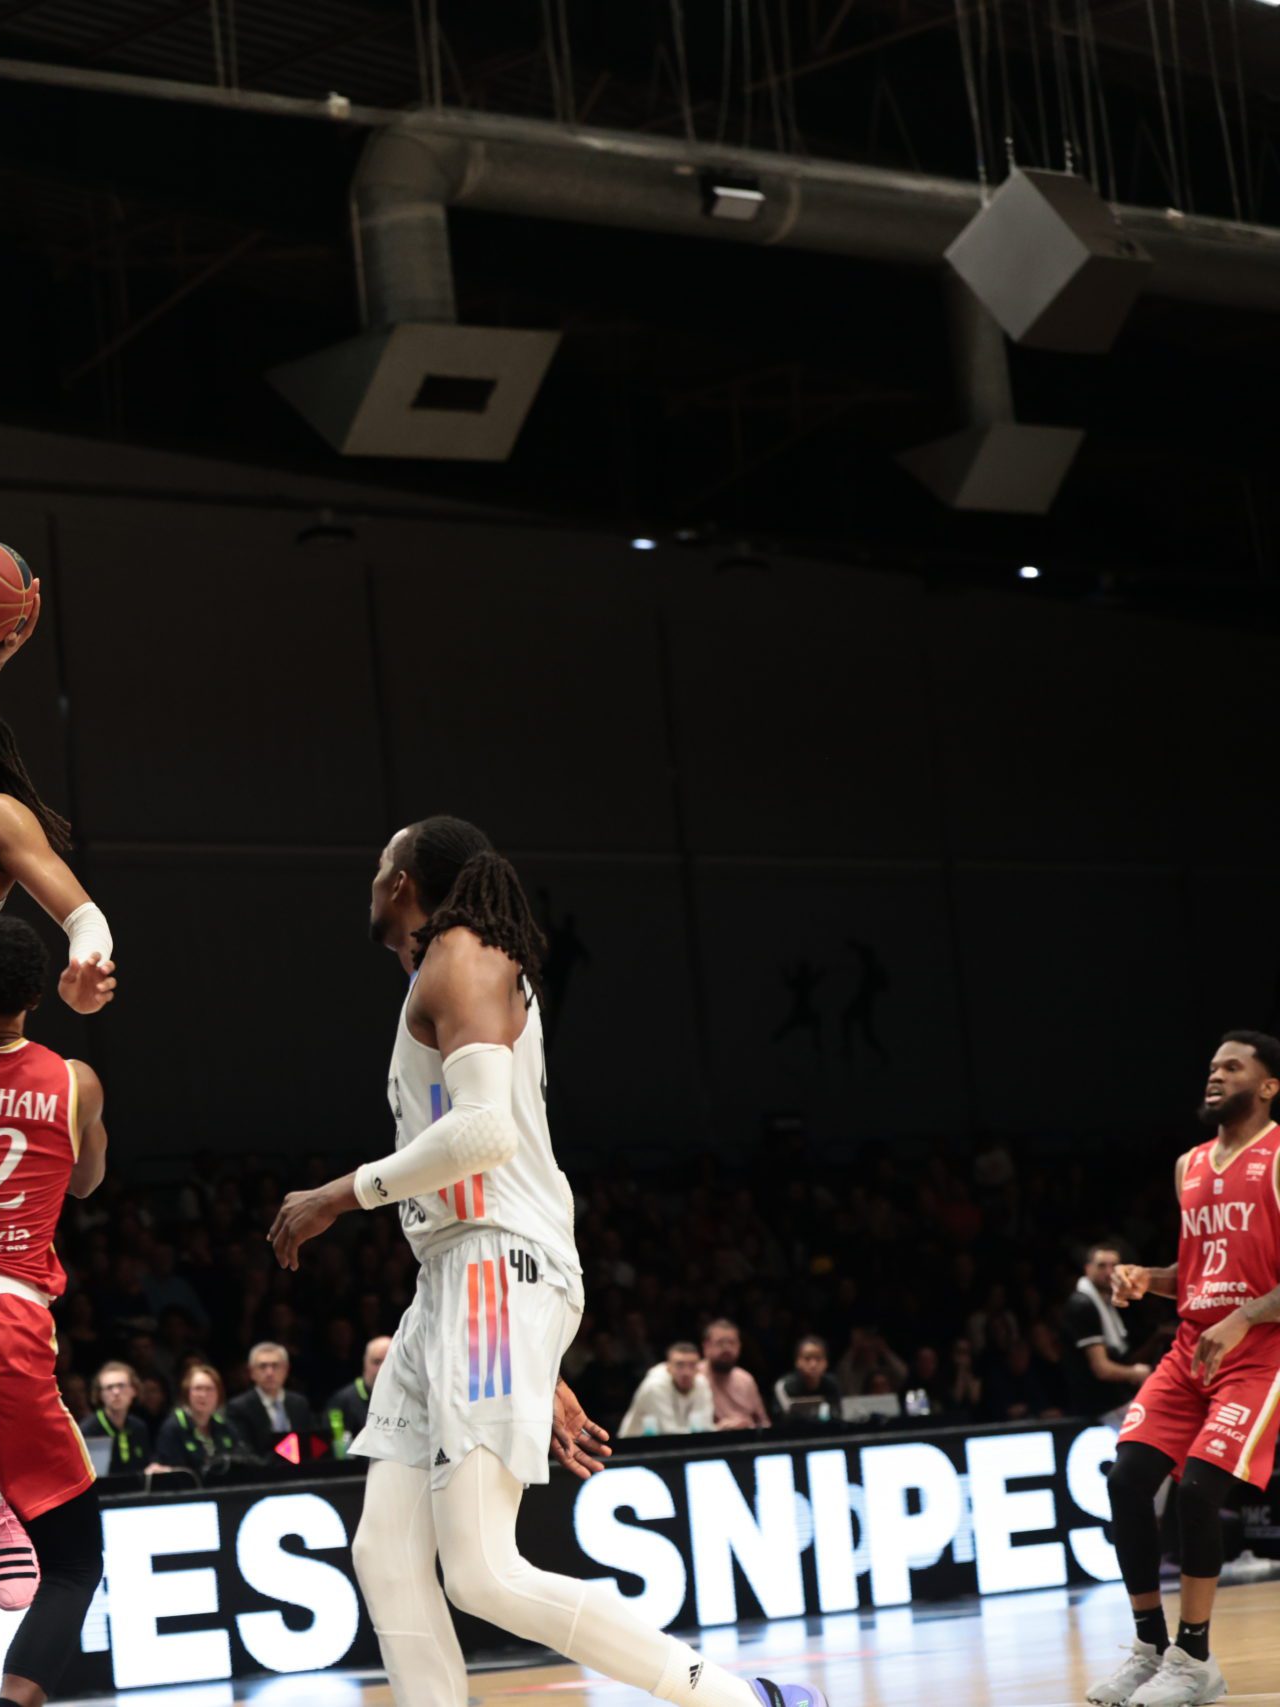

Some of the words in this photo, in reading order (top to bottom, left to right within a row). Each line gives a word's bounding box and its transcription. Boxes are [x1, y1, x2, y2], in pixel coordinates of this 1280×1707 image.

[1182, 1202, 1256, 1239] NANCY
[509, 1249, 538, 1284] 40
[1202, 1237, 1228, 1277] 25
[1201, 1280, 1248, 1296] France
